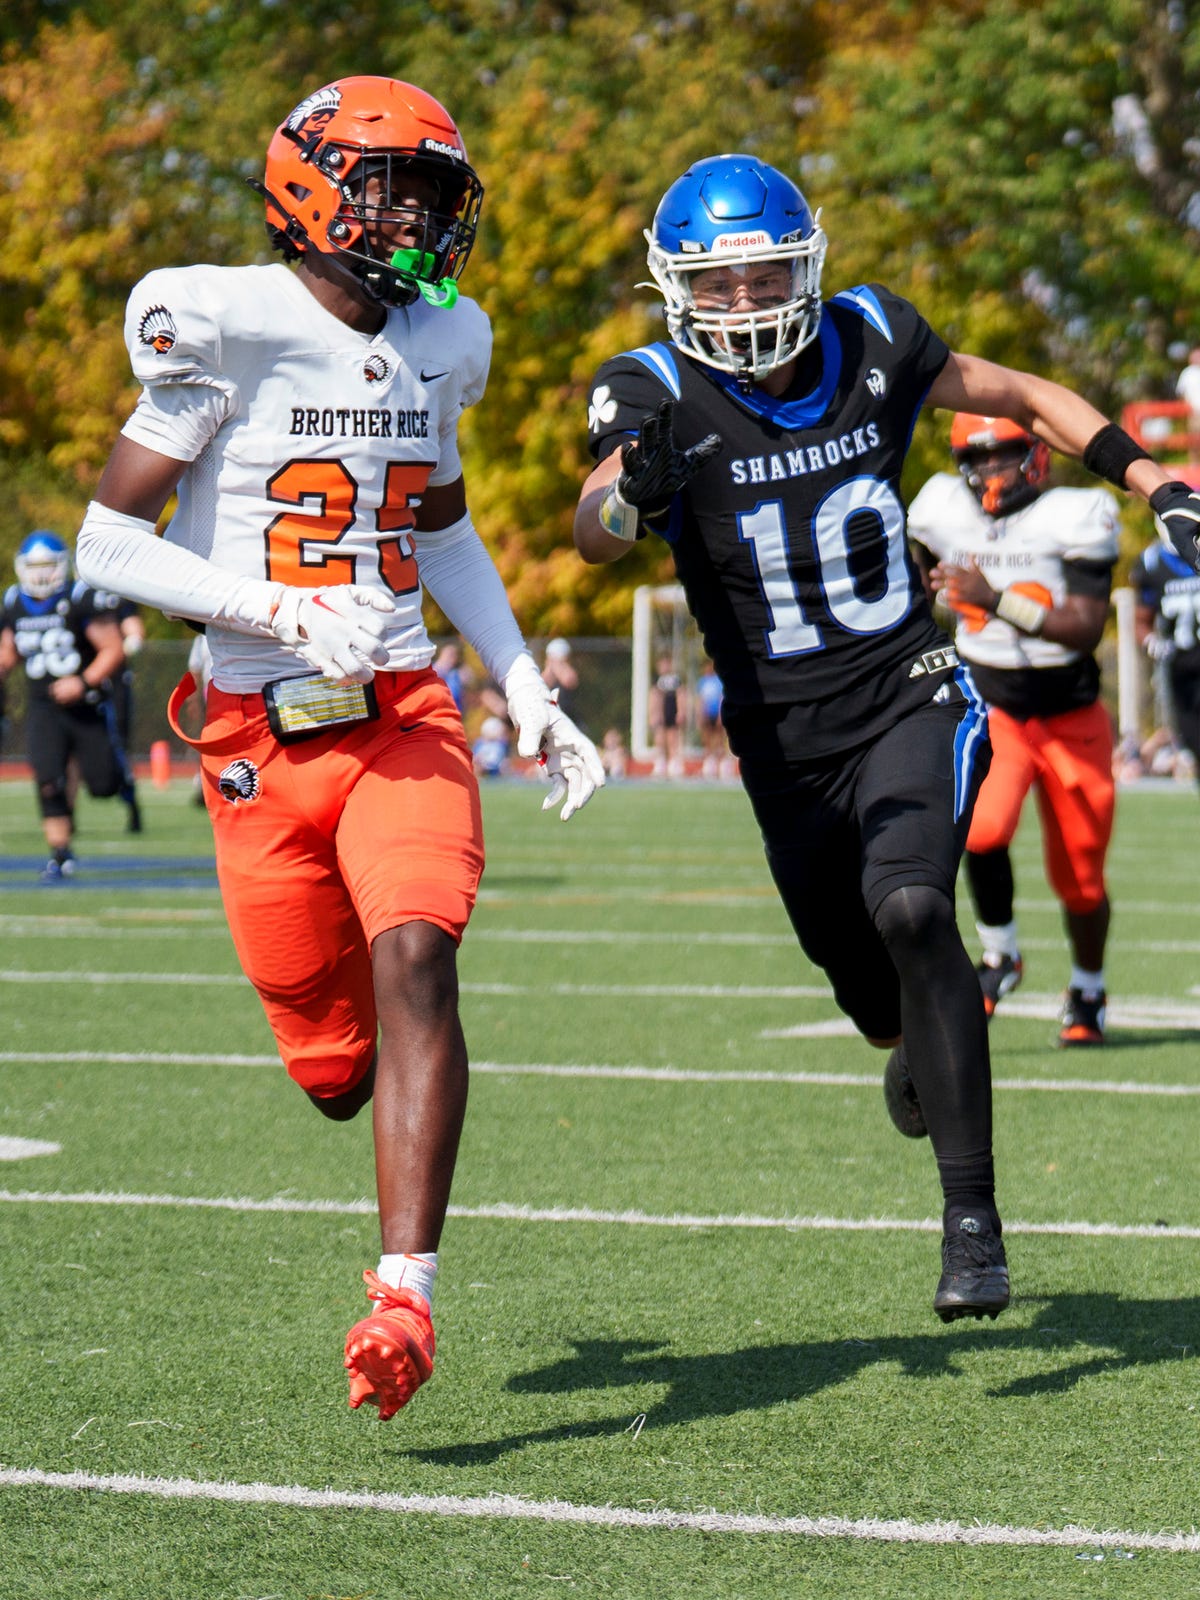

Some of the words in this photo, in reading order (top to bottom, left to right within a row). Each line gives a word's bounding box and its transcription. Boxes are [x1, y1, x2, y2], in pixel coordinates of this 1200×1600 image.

[719, 234, 765, 248] Riddell
[289, 407, 391, 438] BROTHER
[396, 409, 429, 438] RICE
[730, 421, 881, 485] SHAMROCKS
[264, 458, 437, 597] 25
[735, 474, 912, 659] 10
